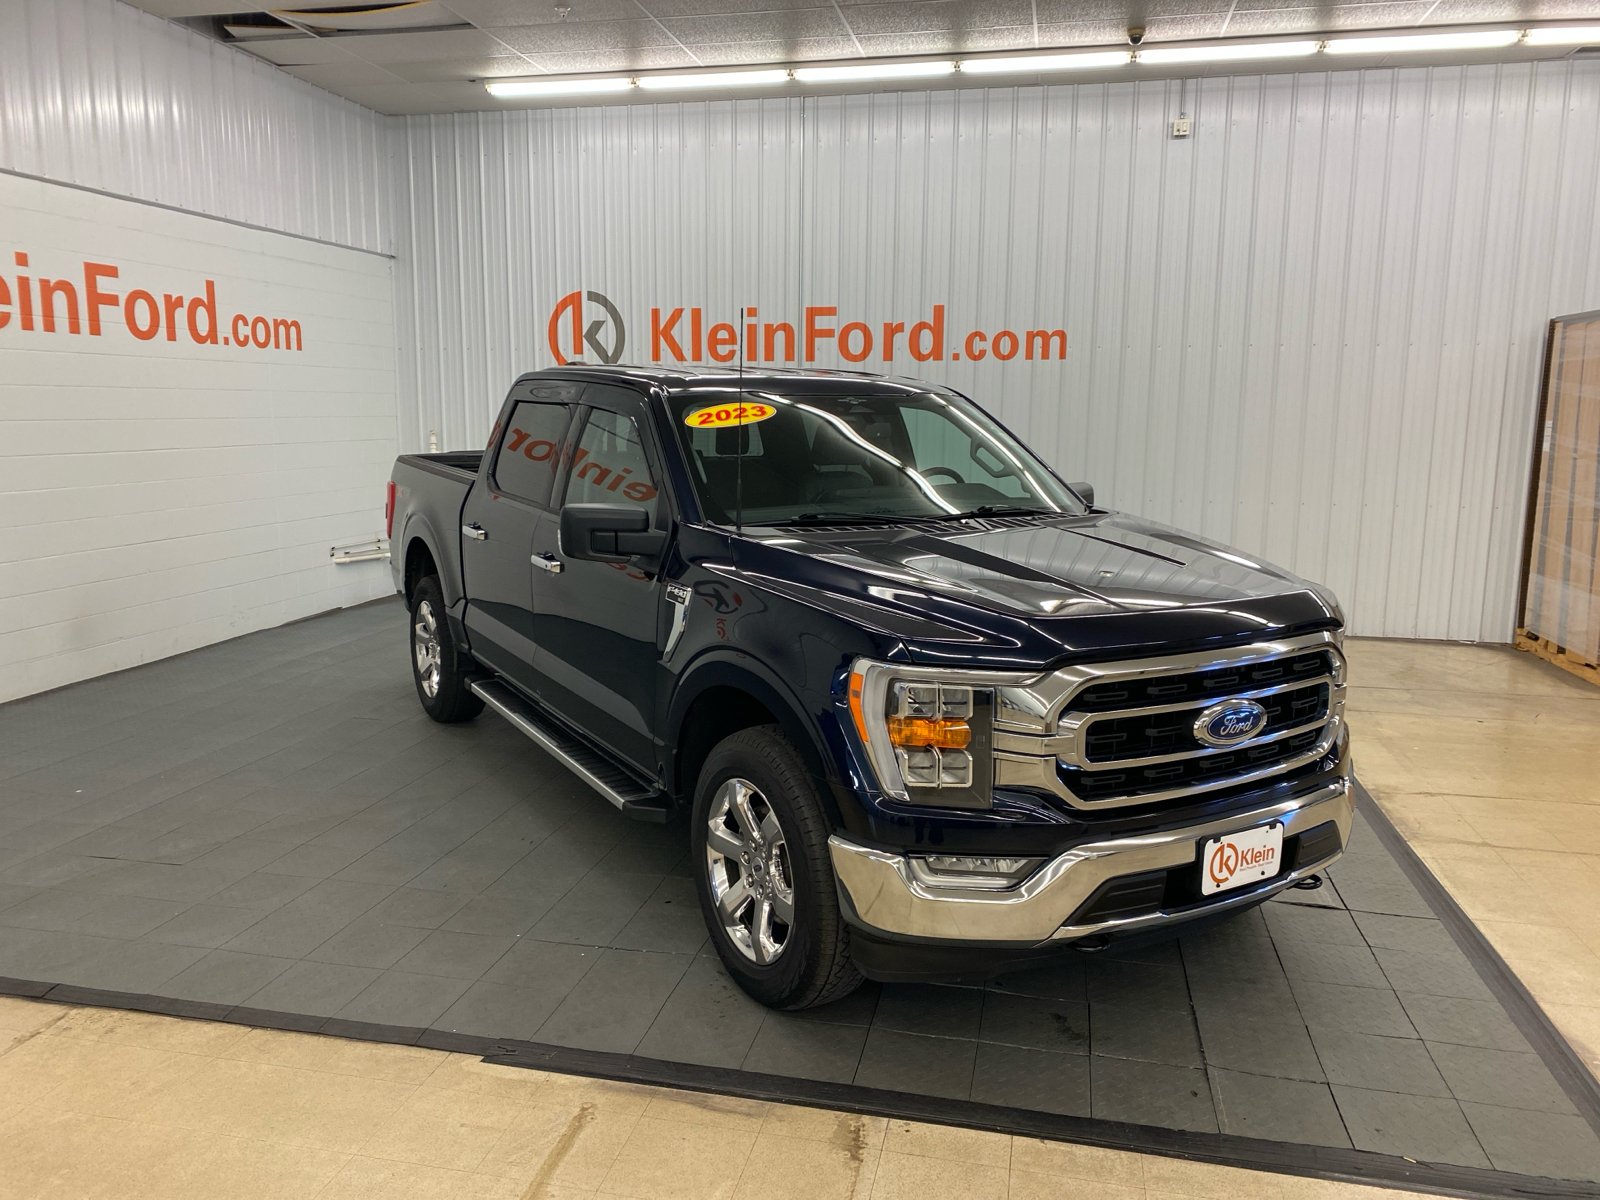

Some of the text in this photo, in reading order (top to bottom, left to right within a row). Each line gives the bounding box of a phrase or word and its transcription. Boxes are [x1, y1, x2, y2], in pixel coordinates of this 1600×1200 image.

[651, 304, 1067, 362] KleinFord.com
[697, 405, 767, 425] 2023
[1220, 713, 1254, 735] Ford
[1239, 844, 1275, 867] Klein
